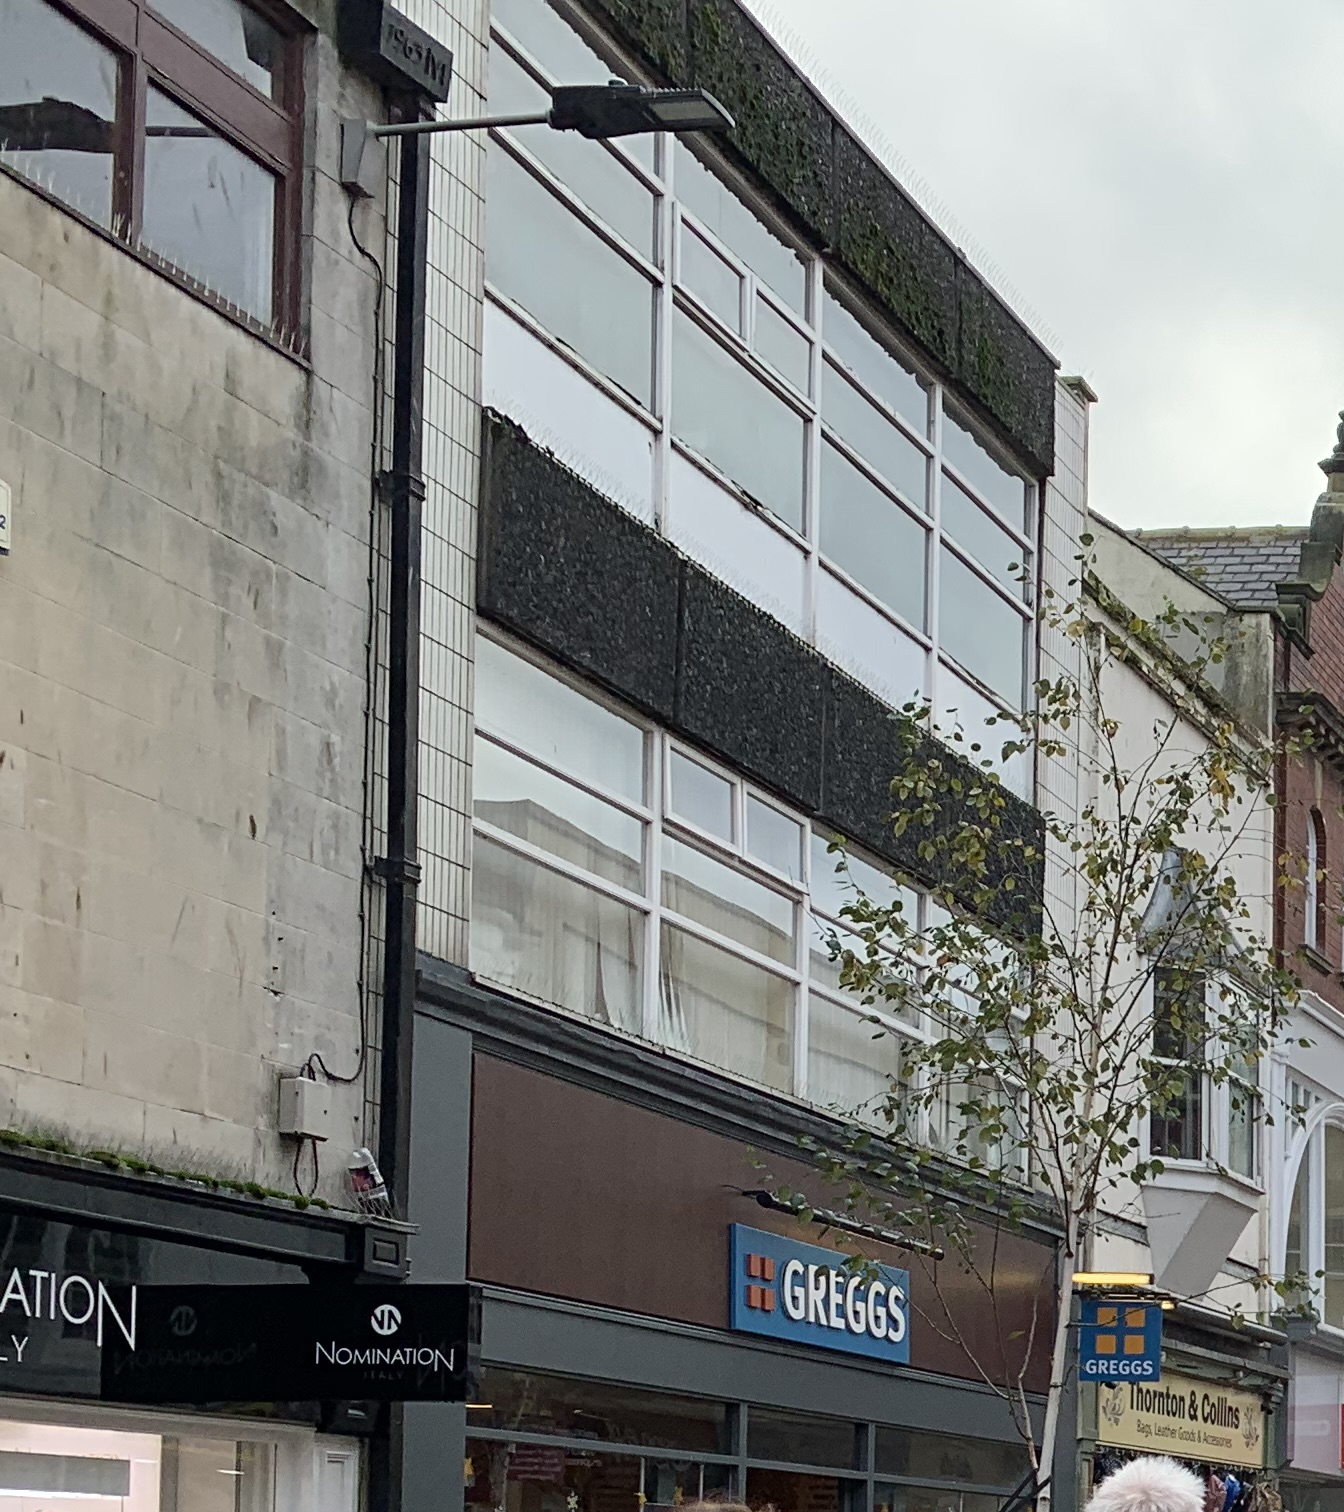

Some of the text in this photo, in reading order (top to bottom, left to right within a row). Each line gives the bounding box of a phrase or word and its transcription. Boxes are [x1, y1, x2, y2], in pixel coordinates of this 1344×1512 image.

[783, 1259, 906, 1343] GREGGS
[316, 1341, 455, 1372] NOMINATION
[1085, 1359, 1153, 1375] GREGGS
[1128, 1382, 1240, 1429] Thornton & Collins
[1154, 1422, 1177, 1438] Leather
[1178, 1427, 1196, 1442] Goods
